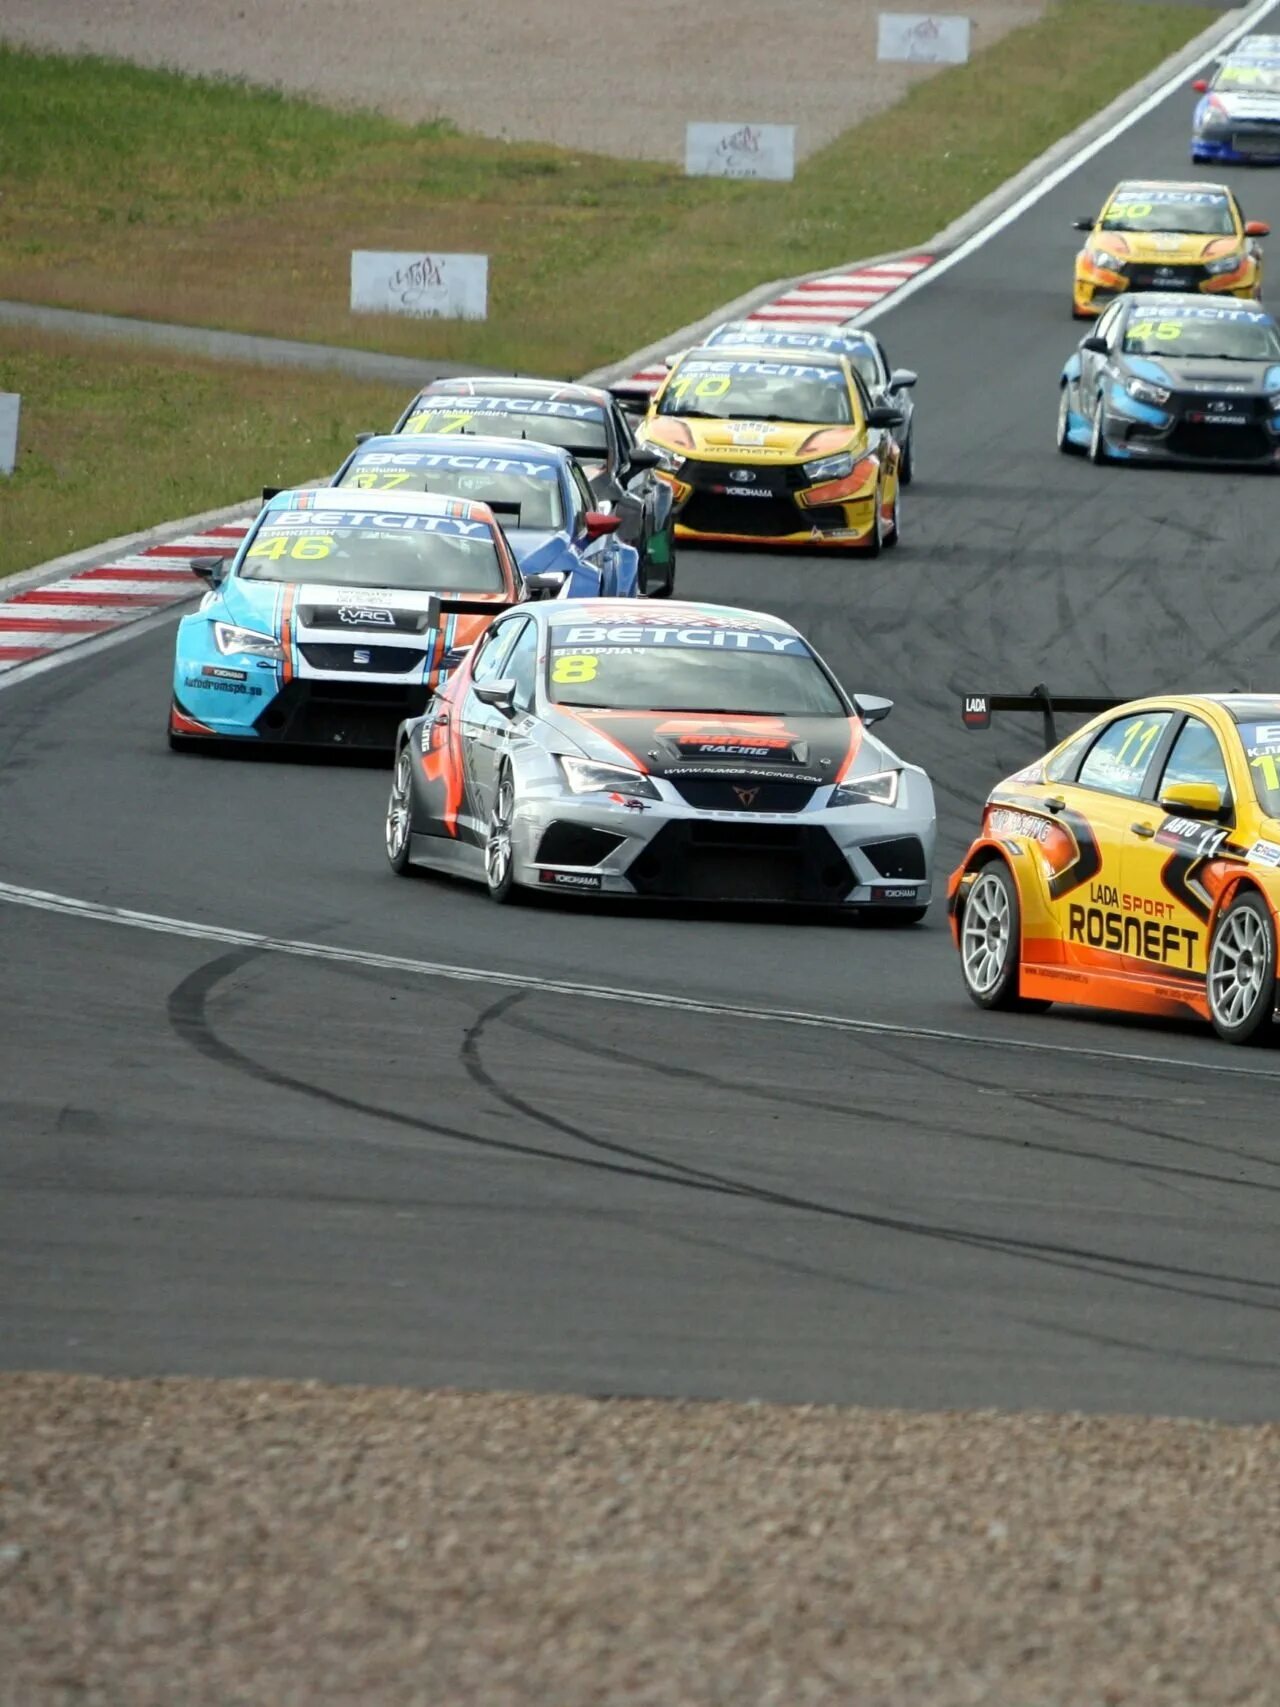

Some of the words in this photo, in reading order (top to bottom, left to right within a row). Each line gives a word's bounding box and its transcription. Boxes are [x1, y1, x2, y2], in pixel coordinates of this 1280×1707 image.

[1134, 306, 1266, 322] BETCITY
[1126, 321, 1182, 340] 45
[682, 361, 839, 379] BETCITY
[671, 377, 731, 398] 10
[423, 396, 598, 418] BETCITY
[405, 414, 474, 433] 17
[358, 453, 550, 475] BETCITY
[273, 512, 484, 535] BETCITY
[246, 536, 334, 560] 46
[347, 609, 387, 621] VRC
[566, 627, 797, 651] BETCITY
[551, 655, 599, 684] 8
[965, 698, 986, 712] LADA
[700, 744, 770, 756] RACING
[1114, 720, 1160, 768] 11
[1163, 817, 1202, 838] АВТО
[1196, 828, 1229, 859] 11
[554, 874, 599, 887] YOKOHAMA
[1090, 882, 1120, 908] LADA
[1122, 894, 1176, 920] SPORT
[1069, 903, 1199, 969] ROSNEFT
